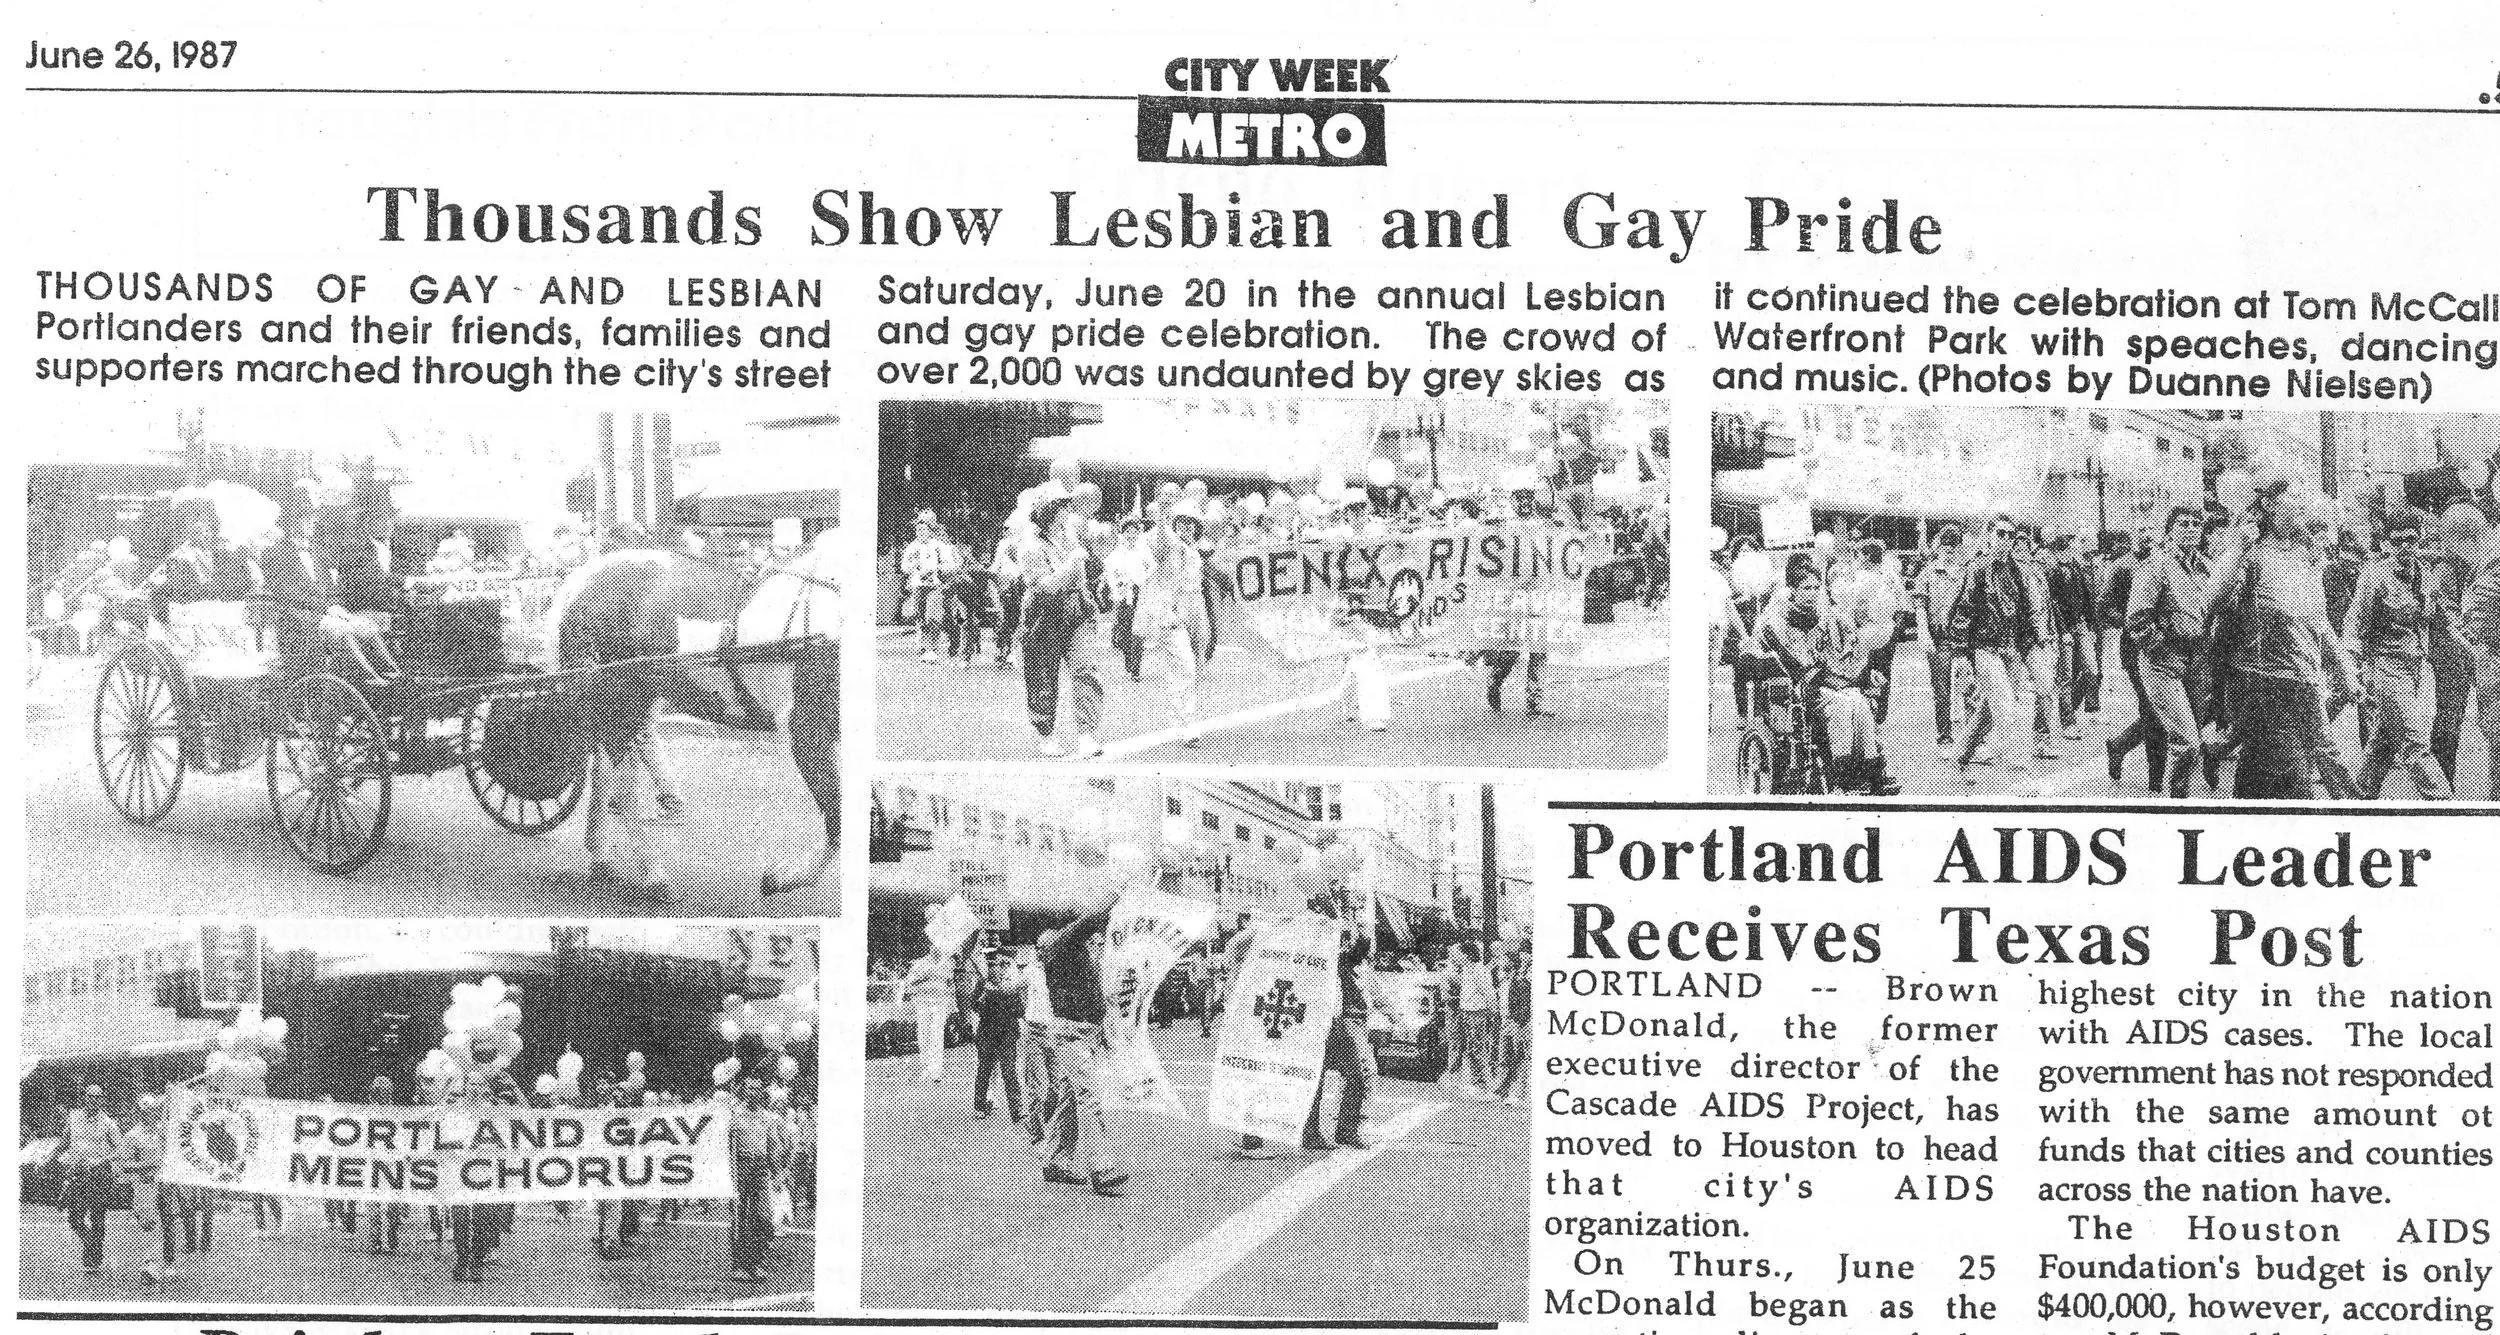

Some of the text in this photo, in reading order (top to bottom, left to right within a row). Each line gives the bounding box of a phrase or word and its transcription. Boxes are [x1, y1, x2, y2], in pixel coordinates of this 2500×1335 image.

[25, 39, 238, 73] June 26, 1987
[1164, 56, 1391, 93] CITY WEEK
[1166, 111, 1367, 159] METRO
[366, 186, 1942, 264] Thousands Show Lesbian and Gay Pride
[36, 270, 821, 308] THOUSANDS OF GAY AND LESBIAN
[878, 274, 1665, 313] Saturday, June 20 in the annual Lesbian
[1715, 281, 2499, 323] it continued the celebration at Tom McCall
[36, 310, 831, 350] Portlanders and their friends, families and
[877, 315, 1667, 353] and gay pride celebration. The crowd of
[1713, 320, 2498, 370] Waterfront Park with speaches, dancing
[35, 352, 832, 394] supporters marched through the city's street
[877, 355, 1665, 398] over 2,000 was undaunted by grey skies as
[1712, 361, 2433, 405] and music. (Photos by Duanne Nielsen)
[1567, 823, 2432, 889] Portland AIDS Leader
[1566, 903, 2364, 968] Receives Texas Post
[1547, 969, 1999, 1002] PORTLAND Brown
[2038, 978, 2493, 1016] highest city in the nation
[1547, 1009, 1999, 1043] McDonald, the former
[2038, 1018, 2493, 1049] with AIDS cases. The local
[1546, 1050, 1999, 1083] executive director of the
[2038, 1059, 2494, 1096] government has not responded
[1546, 1088, 2000, 1129] Cascade AIDS Project, has
[292, 1112, 586, 1151] PORTLAND
[602, 1112, 714, 1147] GAY
[1545, 1130, 1999, 1162] moved to Houston to head
[2038, 1136, 2494, 1167] funds that cities and counties
[458, 1153, 696, 1190] CHORUS
[1546, 1168, 1994, 1208] that city's AIDS
[2038, 1175, 2391, 1205] across the nation have.
[1544, 1210, 1749, 1245] organization.
[2067, 1214, 2490, 1245] The Houston AIDS
[1574, 1248, 1996, 1285] On Thurs., June 25
[2038, 1253, 2493, 1293] Foundation's budget is only
[1544, 1288, 1997, 1326] McDonald began as the
[2037, 1291, 2494, 1332] $400,000, however, according
